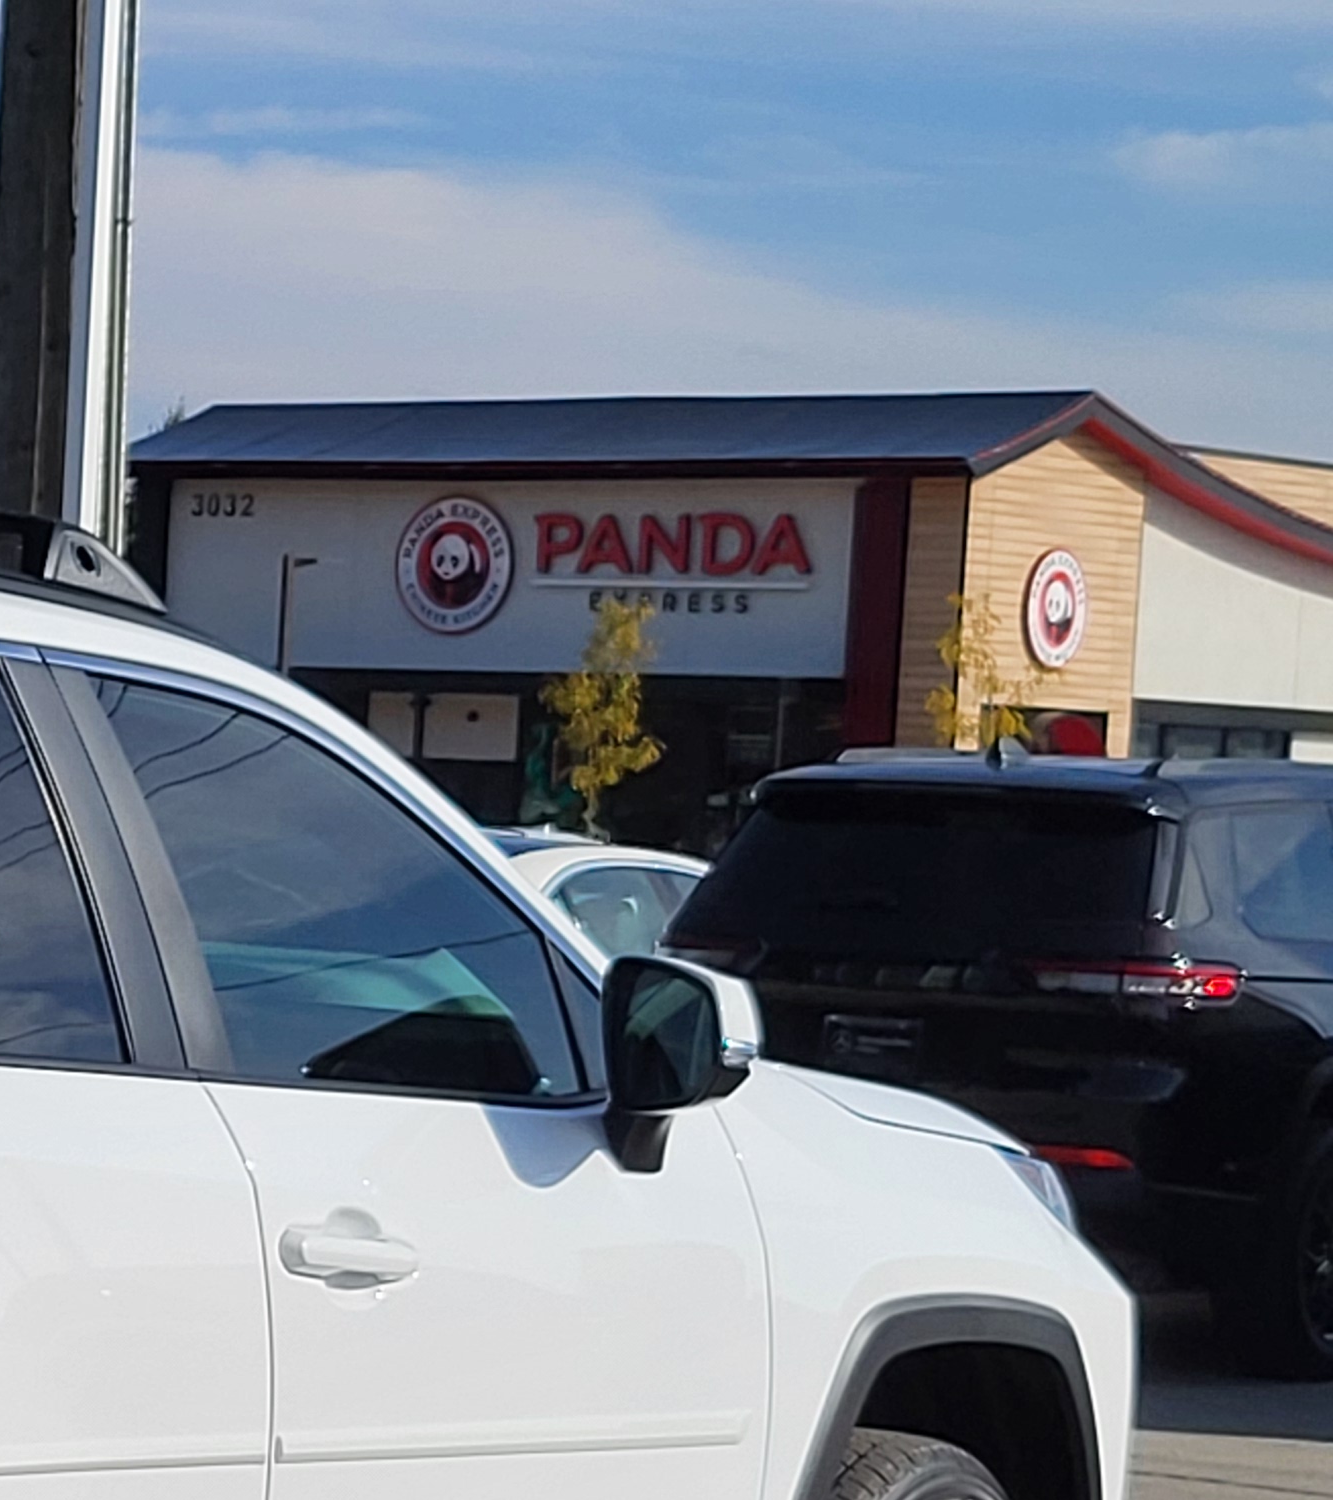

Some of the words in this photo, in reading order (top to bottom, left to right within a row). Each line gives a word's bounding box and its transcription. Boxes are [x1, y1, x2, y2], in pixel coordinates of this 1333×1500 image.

[191, 494, 255, 517] 3032
[403, 508, 445, 559] PANDA
[450, 504, 504, 558] EXPRESS
[534, 514, 813, 576] PANDA
